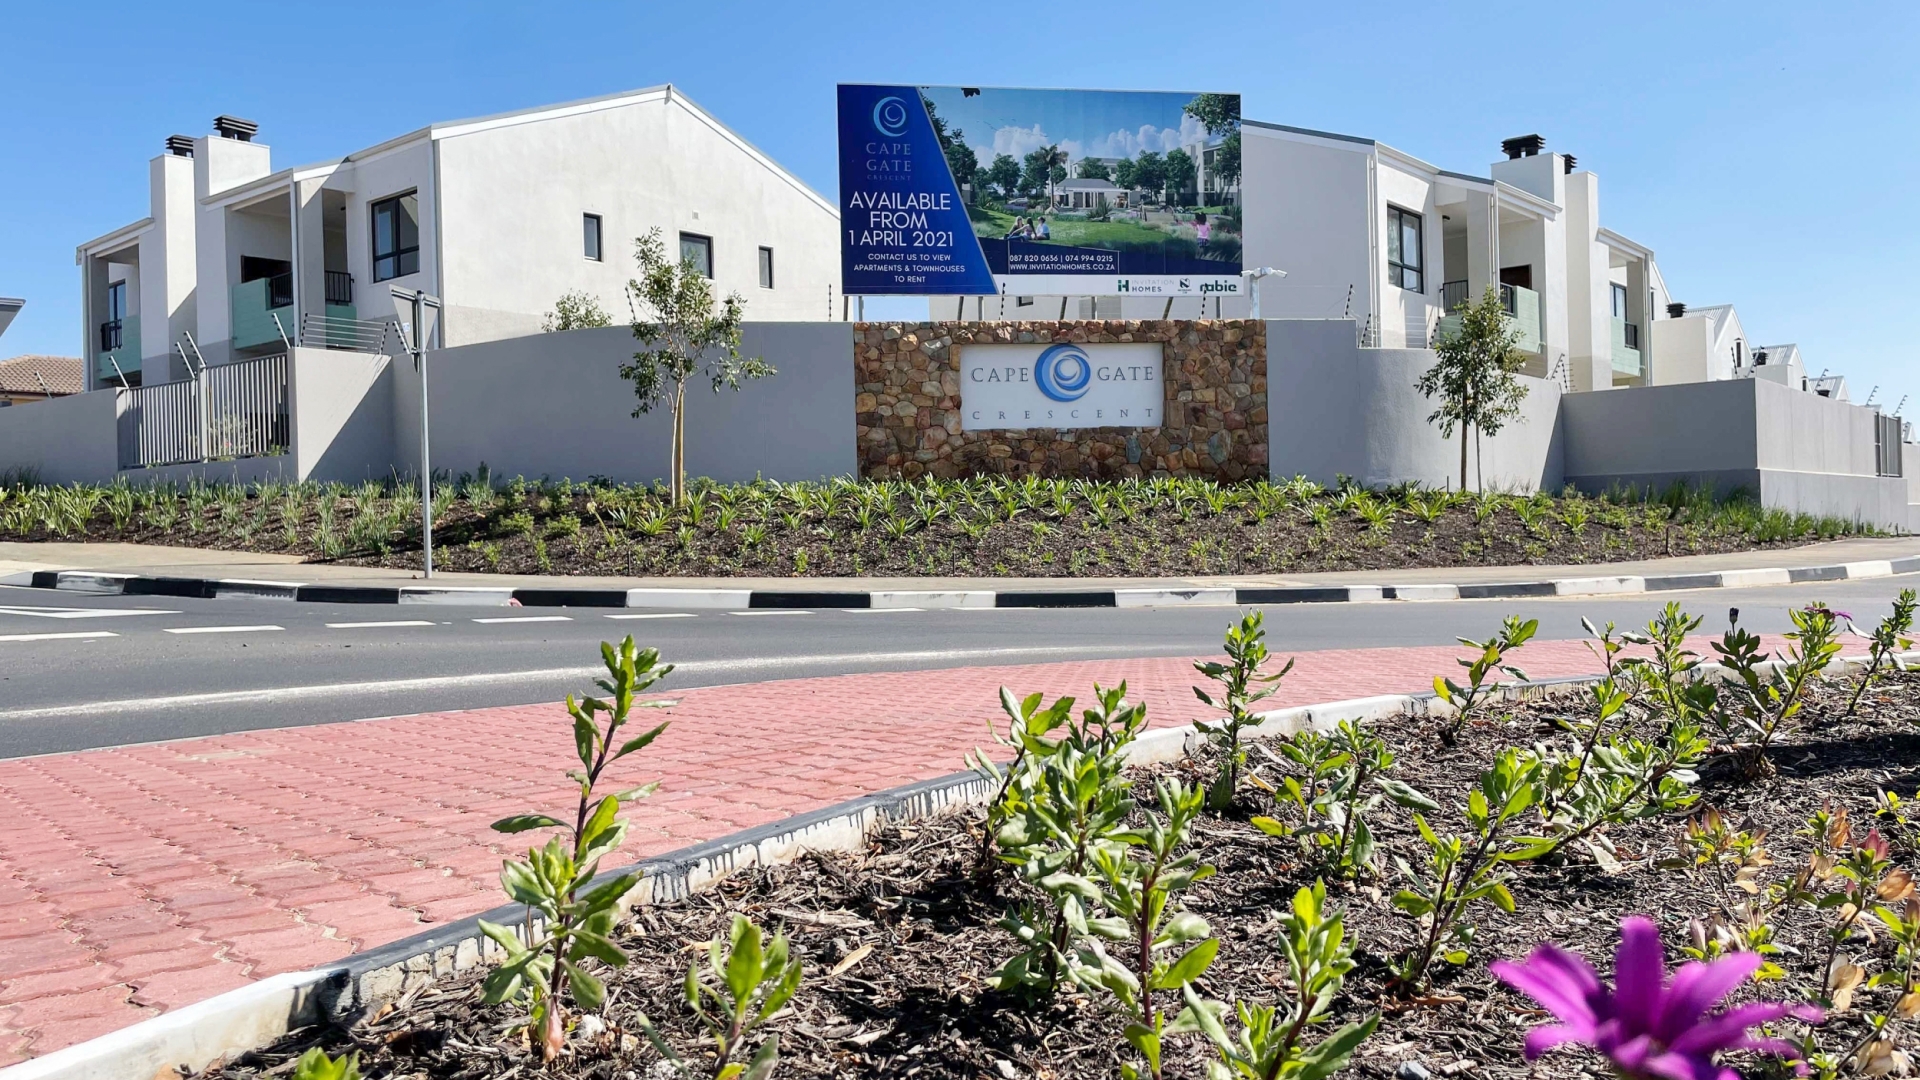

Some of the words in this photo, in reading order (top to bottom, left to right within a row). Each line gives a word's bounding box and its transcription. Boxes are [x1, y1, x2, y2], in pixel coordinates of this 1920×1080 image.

[866, 142, 912, 155] CAPE
[866, 159, 912, 172] GATE
[850, 191, 950, 210] AVAILABLE
[870, 212, 928, 229] FROM
[849, 230, 854, 246] 1
[860, 230, 906, 246] APRIL
[913, 231, 953, 246] 2021
[1200, 280, 1237, 292] rabie
[970, 367, 1028, 382] CAPE
[1097, 366, 1154, 381] GATE
[972, 409, 1153, 419] CRESCENT
